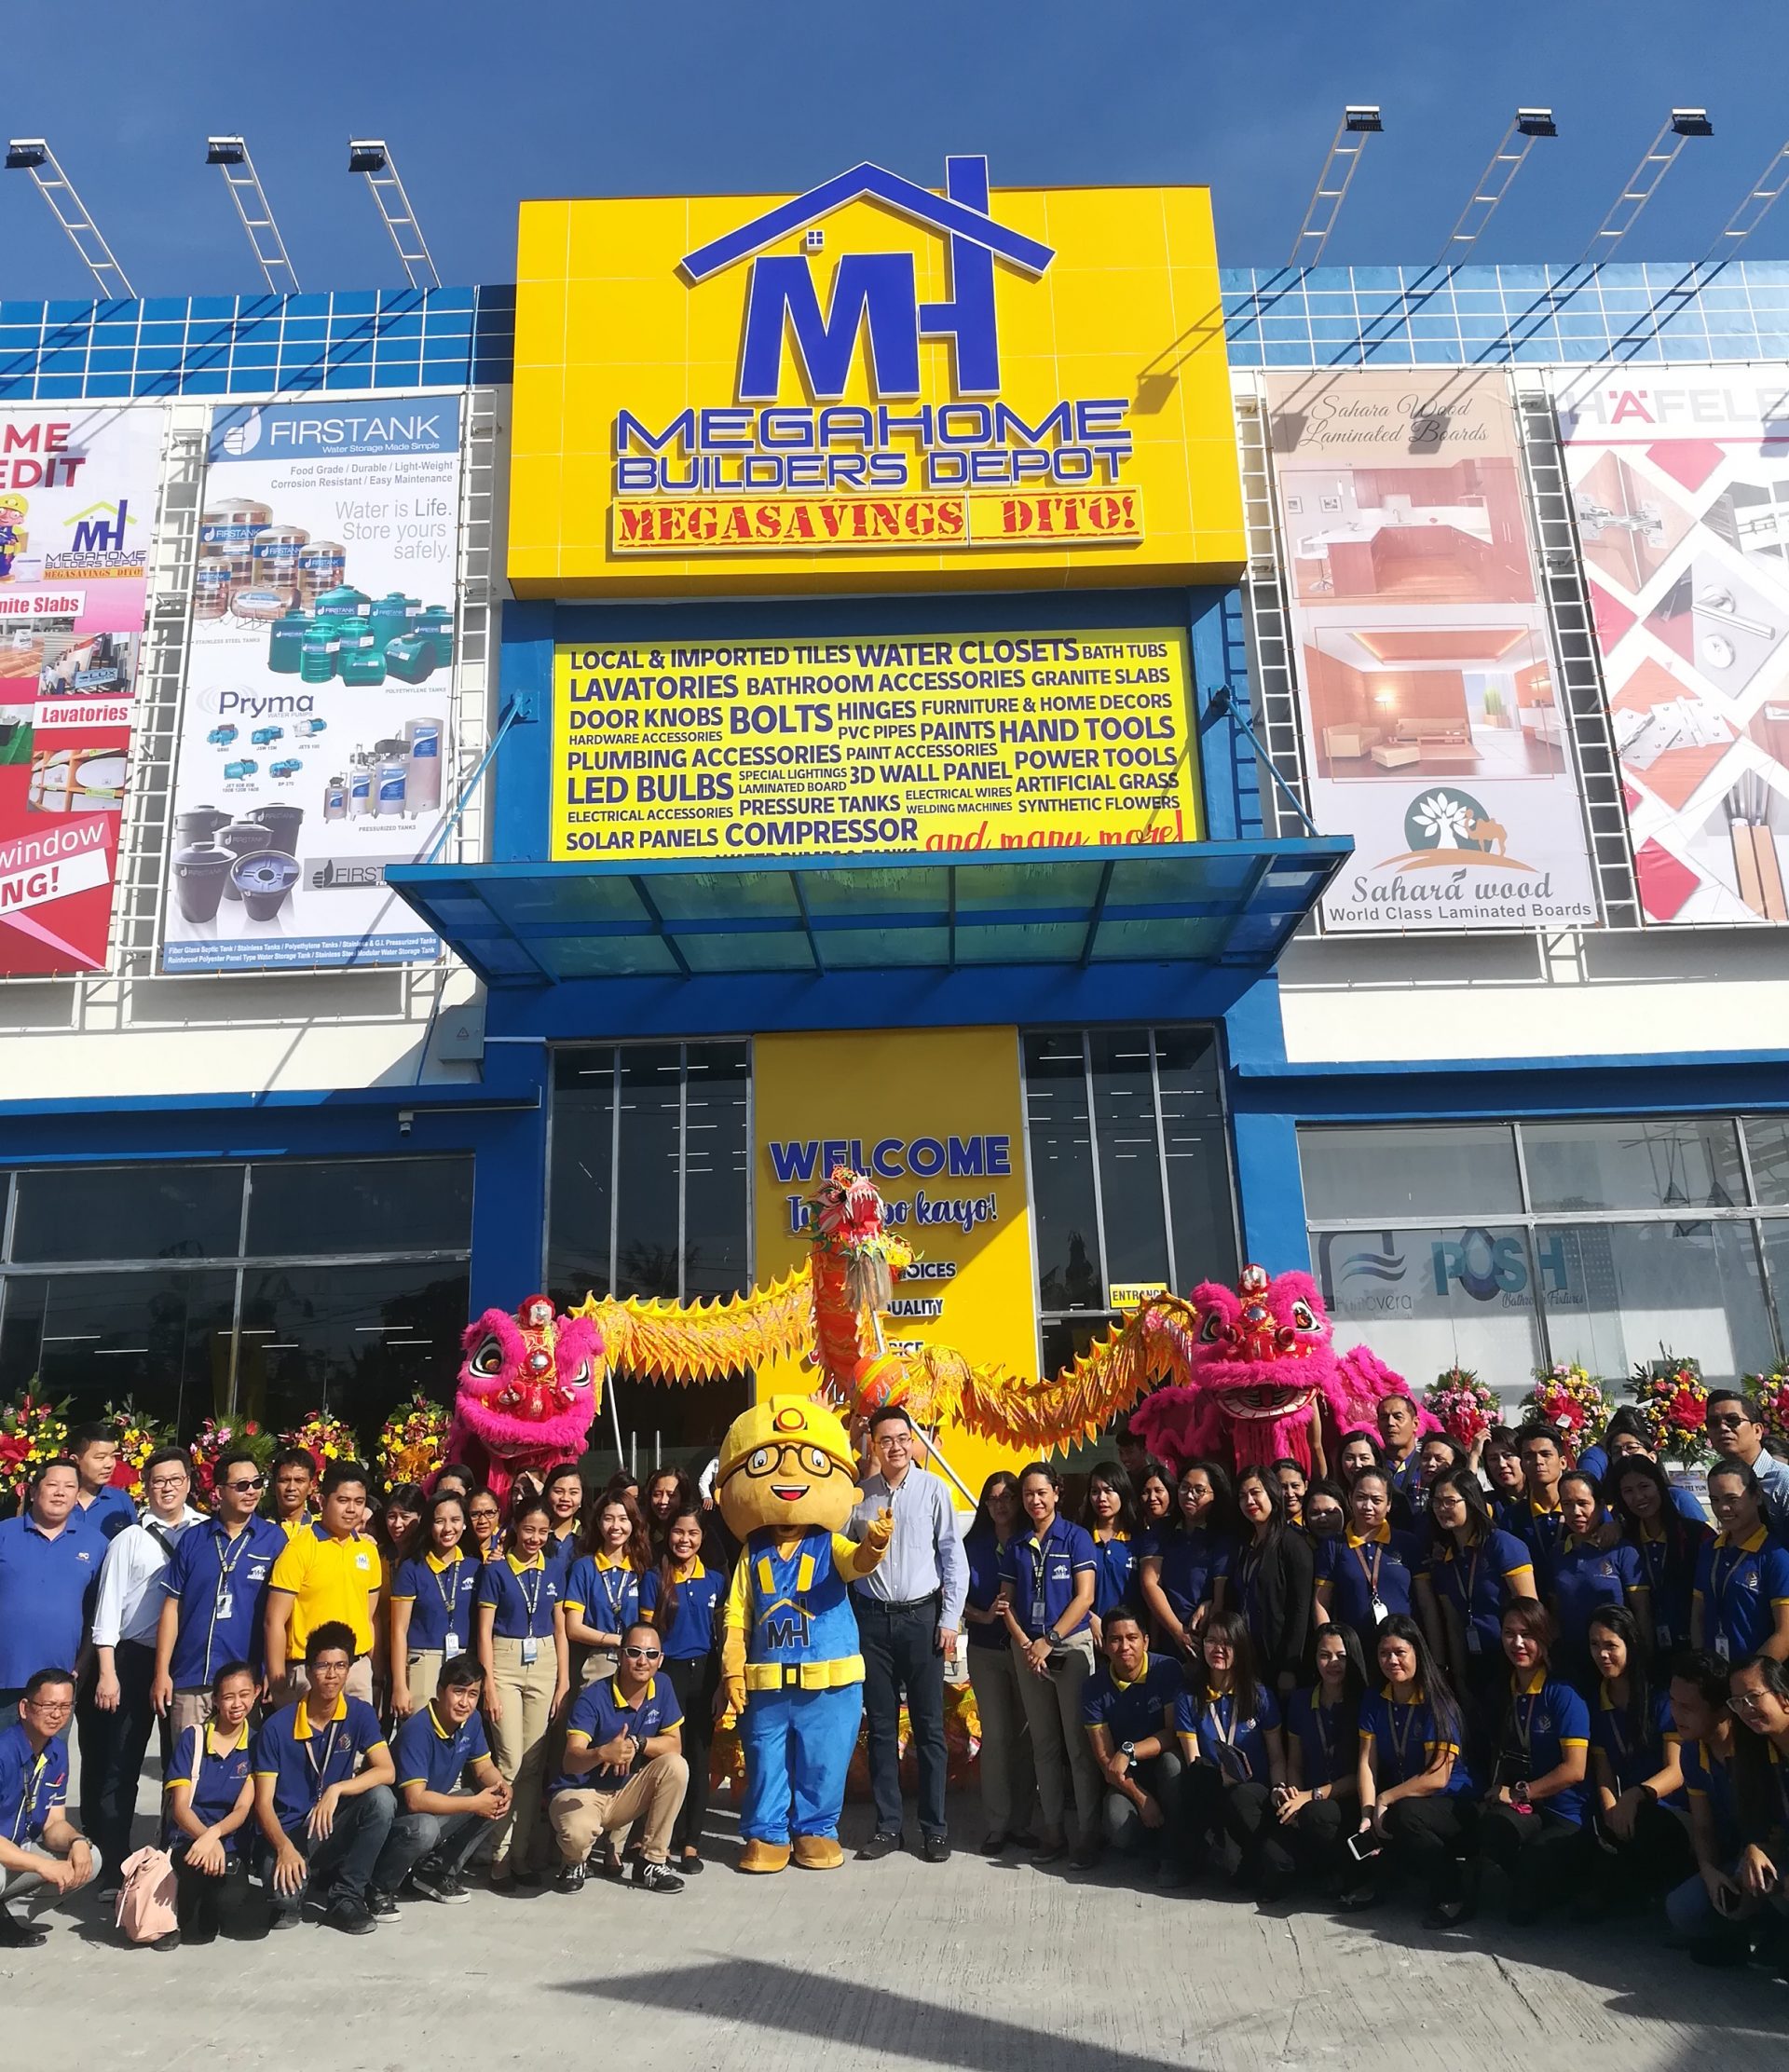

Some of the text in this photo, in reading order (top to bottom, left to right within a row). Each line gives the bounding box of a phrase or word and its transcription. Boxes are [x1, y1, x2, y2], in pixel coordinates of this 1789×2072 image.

[739, 156, 1001, 402] MH
[1312, 394, 1472, 419] Sahara Wood
[270, 416, 440, 445] FIRSTANK
[618, 399, 1132, 455] MEGAHOME
[1299, 419, 1488, 450] Laminated Boards
[322, 443, 440, 454] Water Storage Made Simple
[291, 461, 453, 475] Food Grade Durable Light-Weight
[618, 446, 1132, 494] BUILDERS DEPOT
[271, 474, 453, 489] Corrosion Resistant Easy Maintenance
[335, 498, 452, 519] Water is Life.
[618, 496, 1136, 541] MEGASAVINGS DITO!
[72, 499, 128, 552] MH
[343, 521, 446, 543] Store yours
[47, 551, 146, 562] MEGAHOME
[394, 540, 450, 563] safely.
[46, 559, 143, 569] BUILDERS DEPOT
[46, 569, 110, 579] MEGASAVINGS
[34, 596, 79, 612] Slabs
[570, 639, 1168, 670] LOCAL & IMPORTED TILES WATER CLOSETS BATH TUBS
[570, 668, 1170, 702] LAVATORIES BATHROOM ACCESSORIES GRANITE SLABS
[42, 705, 128, 723] Lavatories
[219, 691, 314, 718] Pryma
[569, 693, 1172, 734] DOOR KNOBS BOLTS HINGES FURNITURE & HOME DECORS
[569, 716, 1175, 745] HARDWARE ACCESSORIES PVC PIPES PAINTS HAND TOOLS
[568, 743, 1177, 770] PLUMBING ACCESSORIES PAINT ACCESSORIES POWER TOOLS
[739, 768, 847, 781] SPECIAL LIGHTINGS
[850, 761, 1012, 784] 3D WALL PANEL
[1016, 772, 1179, 793] ARTIFICIAL GRASS
[567, 772, 733, 804] LED BULBS
[739, 781, 847, 795] LAMINATED BOARD
[906, 787, 1012, 800] ELECTRICAL WIRES
[568, 796, 901, 824] ELECTRICAL ACCESSORIES PRESSURE TANKS
[907, 801, 1012, 814] WELDING MACHINES
[1018, 796, 1180, 813] SYNTHETIC FLOWERS
[567, 818, 918, 851] SOLAR PANELS COMPRESSOR
[926, 820, 991, 851] and
[1351, 869, 1553, 902] Sahara wood
[1330, 903, 1591, 921] World Class Laminated Boards
[199, 955, 225, 963] Polyester
[275, 952, 295, 961] Storage
[399, 947, 419, 956] Storage
[201, 946, 218, 954] Septic
[285, 942, 321, 950] Polyethylene
[769, 1135, 1011, 1182] WELCOME
[915, 1190, 998, 1234] kayo!
[902, 1262, 956, 1279] OICES
[887, 1299, 944, 1315] UALITY
[768, 1598, 810, 1649] MH
